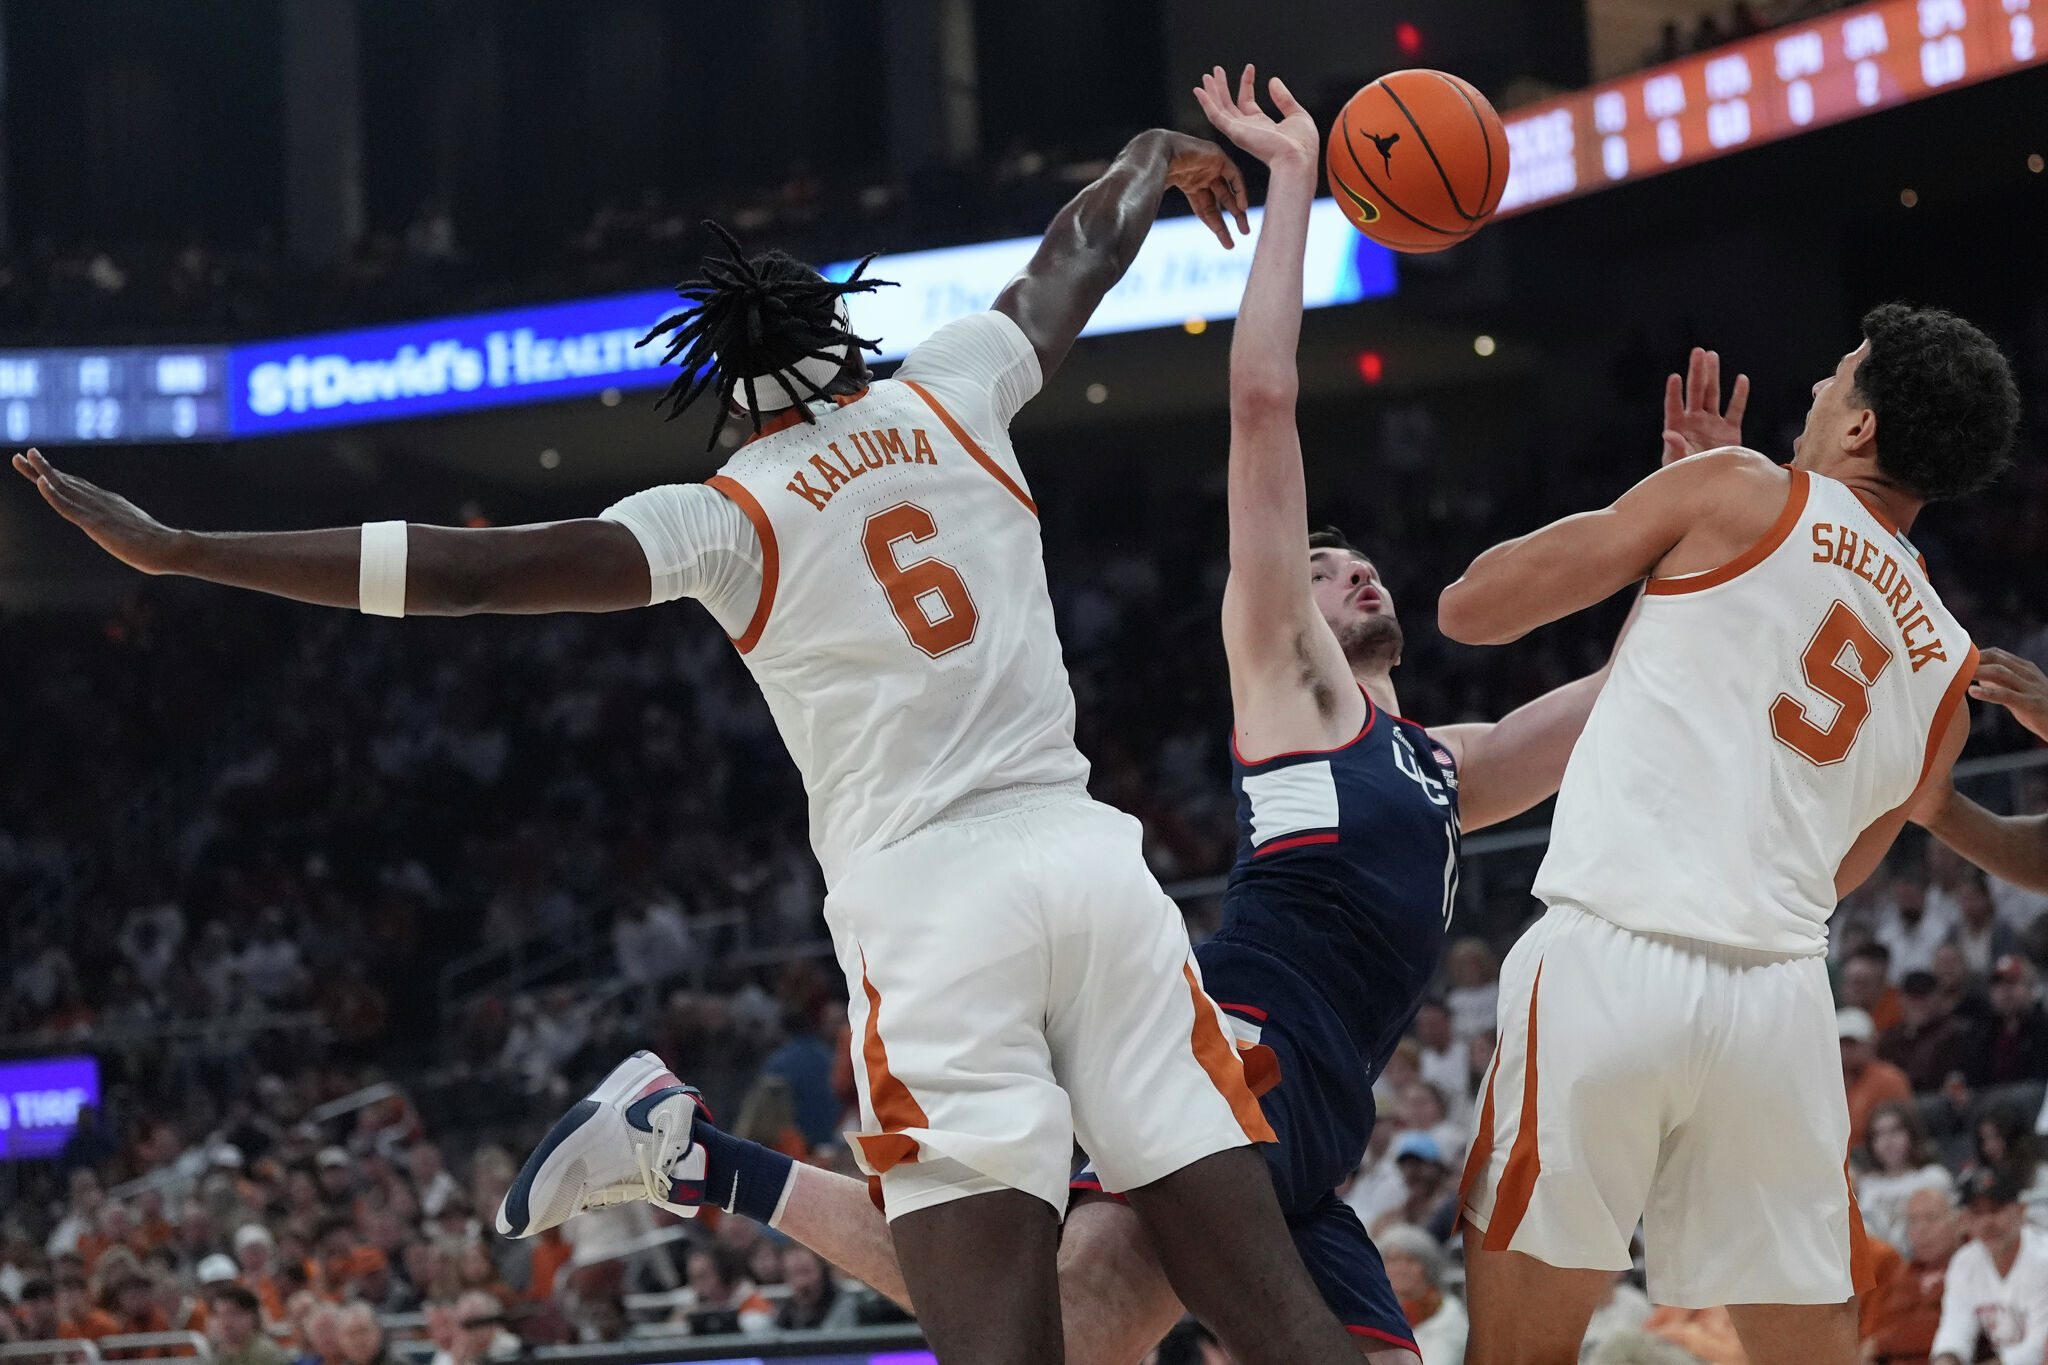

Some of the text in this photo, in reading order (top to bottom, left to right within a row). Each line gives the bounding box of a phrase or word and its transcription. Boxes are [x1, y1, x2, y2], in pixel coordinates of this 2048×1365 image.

[786, 428, 938, 512] KALUMA
[861, 500, 980, 660] 6
[1812, 523, 1947, 673] SHEDRICK
[1769, 598, 1893, 767] 5
